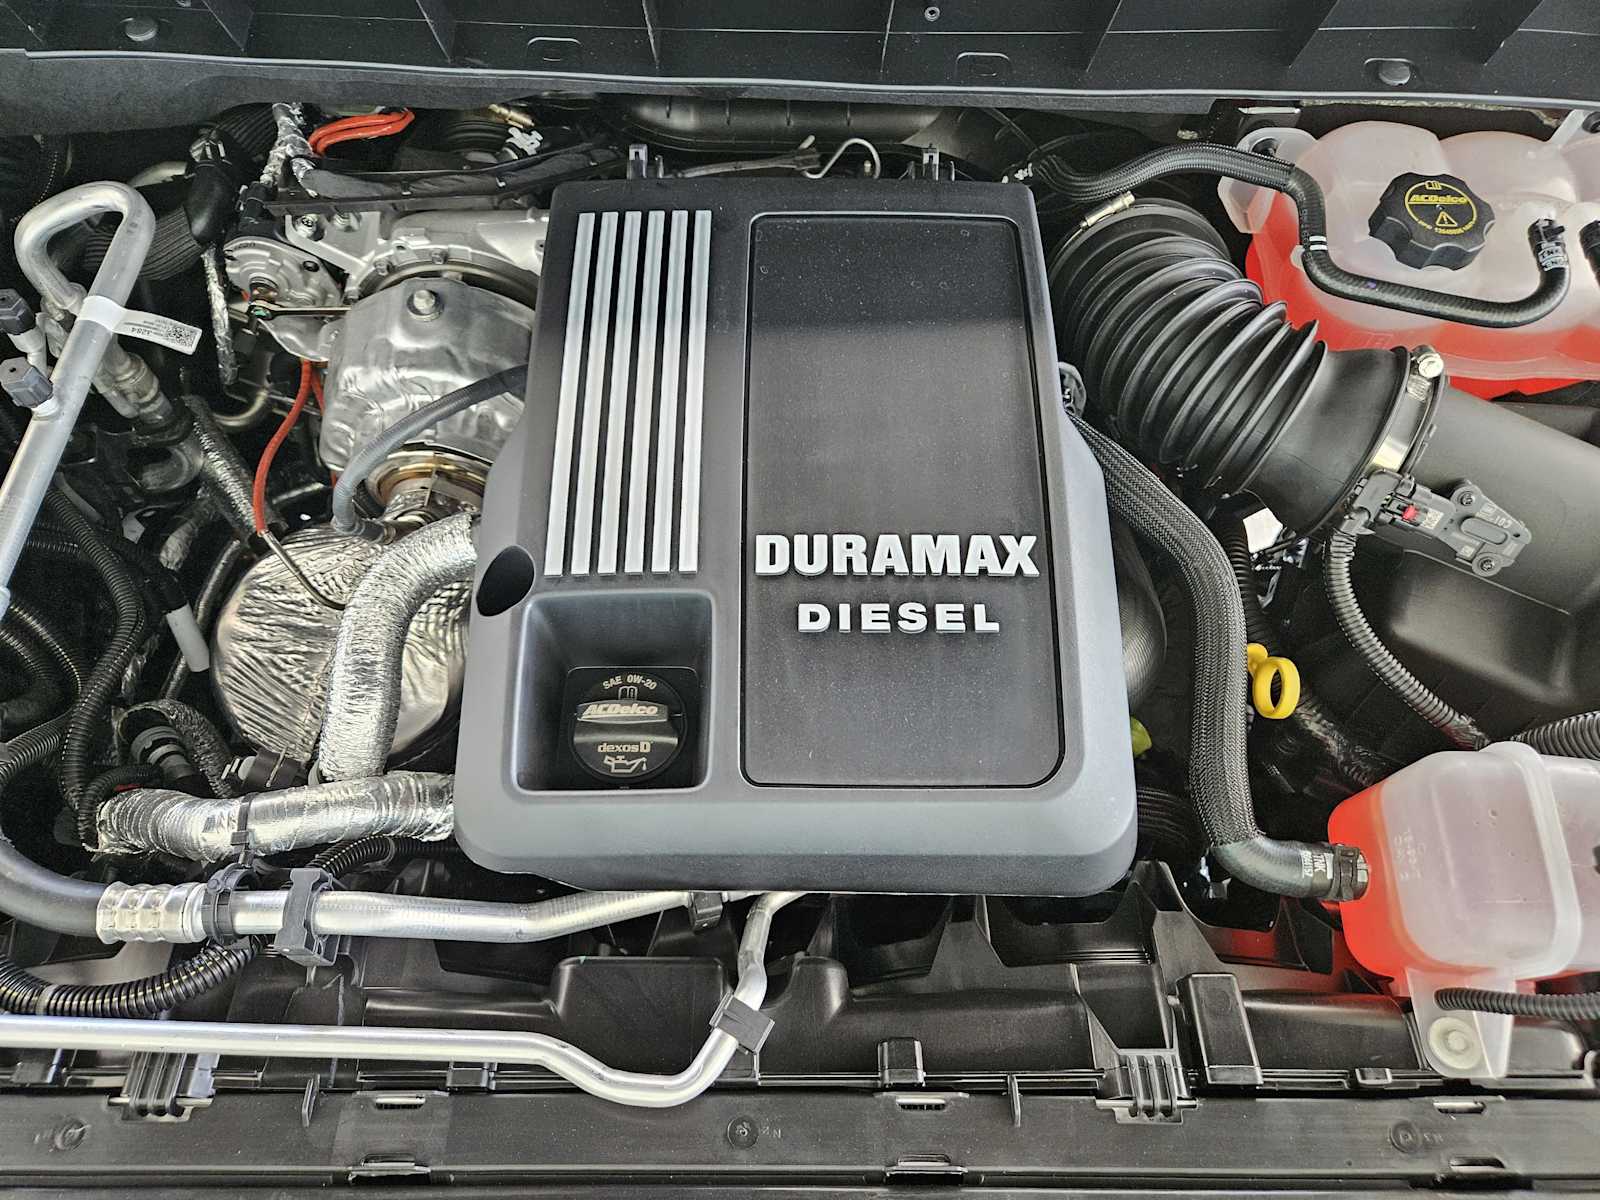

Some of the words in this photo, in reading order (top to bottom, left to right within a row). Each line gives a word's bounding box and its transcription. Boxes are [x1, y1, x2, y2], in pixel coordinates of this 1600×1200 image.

[1409, 194, 1468, 204] ACDelco
[755, 534, 1040, 577] DURAMAX
[798, 602, 1000, 633] DIESEL
[602, 675, 623, 690] SAE
[626, 674, 658, 690] 0W-20
[581, 703, 659, 719] ACDelco
